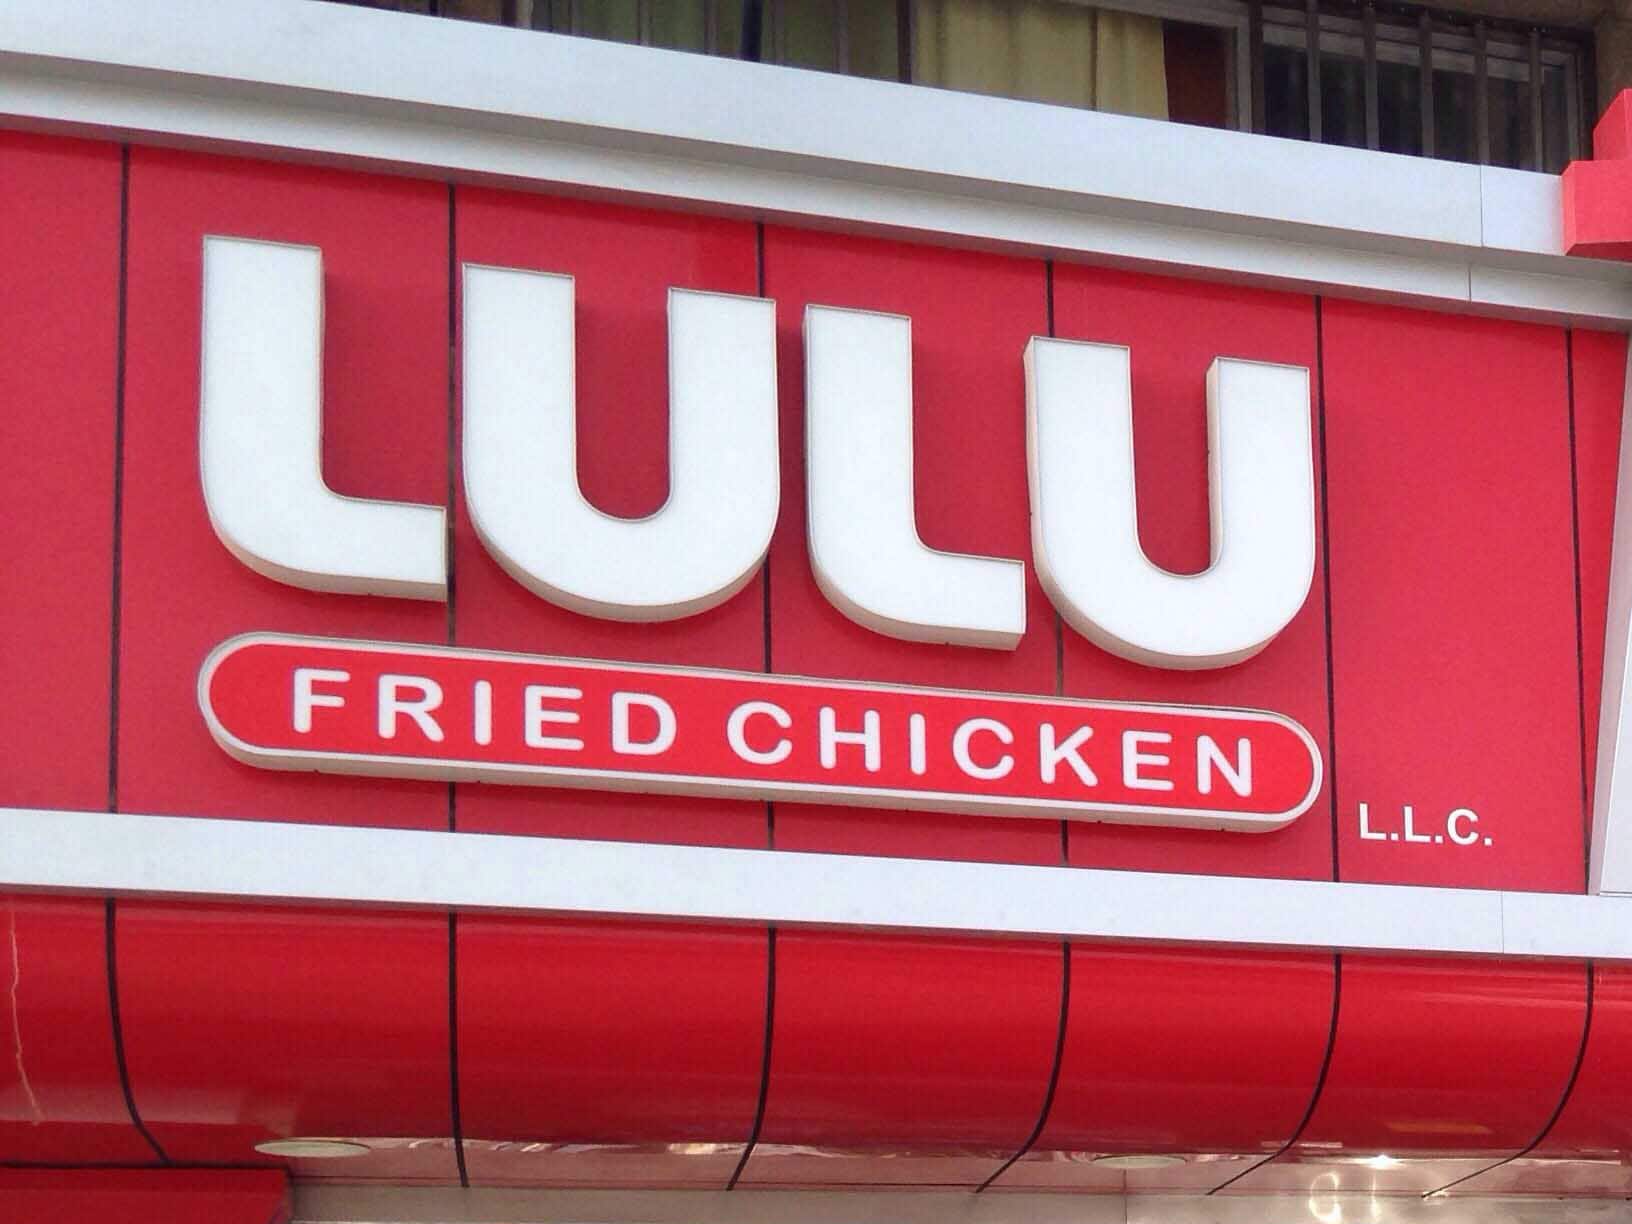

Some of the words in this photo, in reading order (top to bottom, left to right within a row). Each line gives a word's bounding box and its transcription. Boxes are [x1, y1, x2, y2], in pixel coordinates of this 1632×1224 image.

[199, 235, 1316, 669] LULU
[292, 668, 678, 756] FRIED
[726, 700, 1255, 798] CHICKEN
[1357, 801, 1494, 847] L.L.C.
